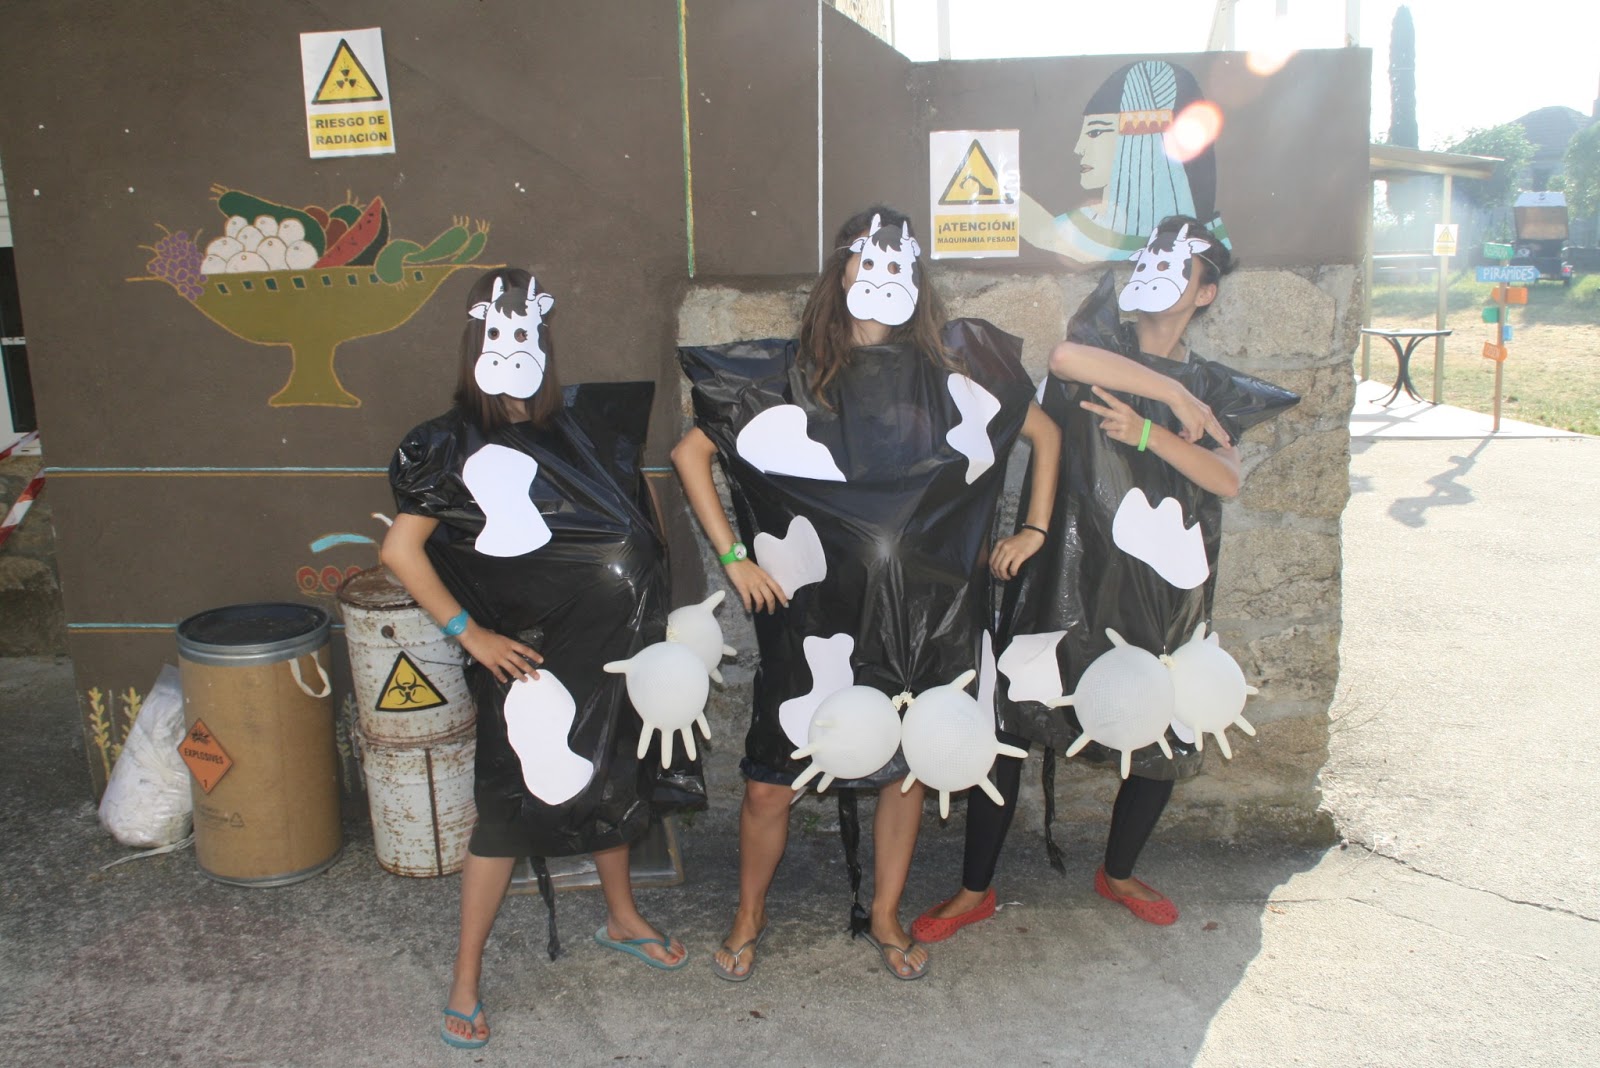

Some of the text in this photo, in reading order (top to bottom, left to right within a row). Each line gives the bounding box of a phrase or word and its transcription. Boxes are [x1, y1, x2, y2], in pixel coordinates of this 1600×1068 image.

[315, 115, 385, 129] RIESGO DE
[315, 131, 388, 145] RADIACIÓN
[938, 219, 1015, 235] ¡ATENCIÓN!
[937, 236, 985, 244] MAQUINARIA
[184, 748, 224, 765] EXPLOSIVES
[203, 778, 208, 789] 1
